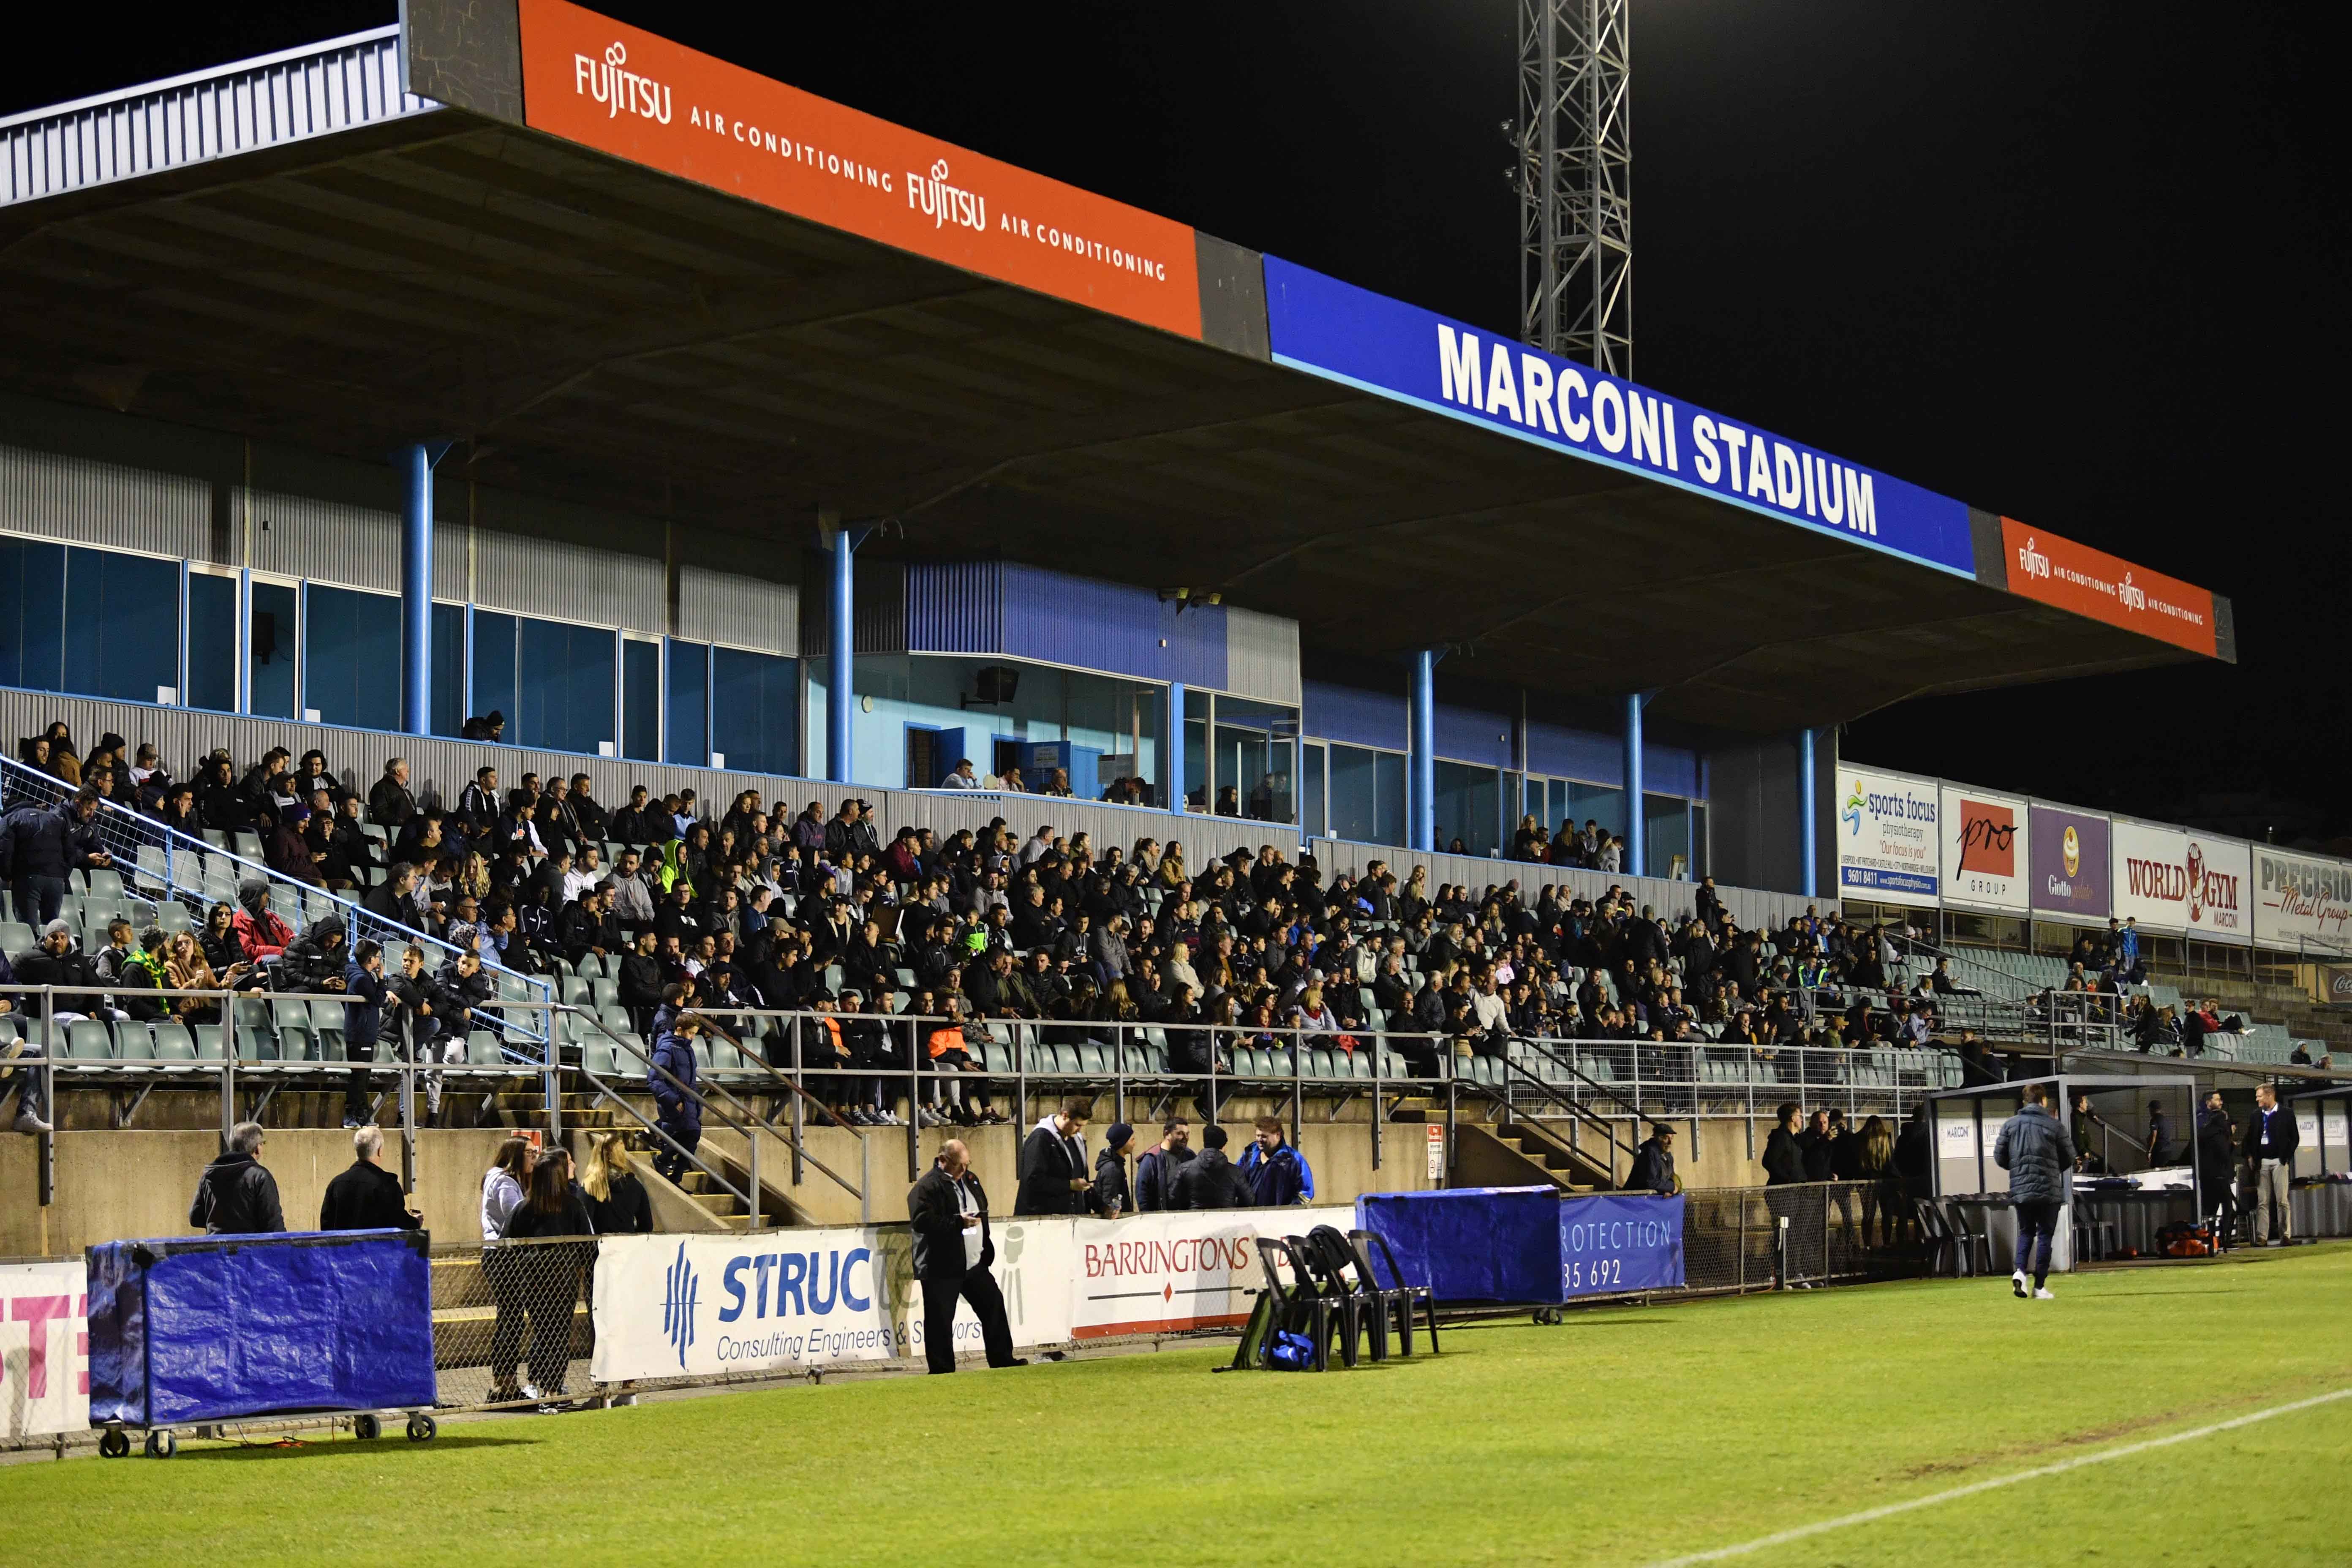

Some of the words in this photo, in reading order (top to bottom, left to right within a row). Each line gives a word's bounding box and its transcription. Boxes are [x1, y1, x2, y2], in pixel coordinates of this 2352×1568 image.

[574, 53, 672, 125] FUJITSU
[691, 106, 725, 135] AIR
[734, 121, 892, 193] CONDITIONING
[906, 172, 985, 231] FUJITSU
[1000, 213, 1030, 238] AIR
[1036, 224, 1165, 281] CONDITIONING
[1437, 324, 1678, 471] MARCONI
[1693, 414, 1877, 536] STADIUM
[2019, 547, 2049, 580] FUJITSU
[2054, 565, 2065, 579] AIR
[2066, 569, 2116, 596] CONDITIONING
[2118, 582, 2145, 612] FUJITSU
[2148, 598, 2159, 610] AIR
[2159, 601, 2203, 626] CONDITIONING
[1869, 792, 1904, 820] sports
[1906, 792, 1935, 823] focus
[1882, 820, 1923, 842] physiotherapy
[1893, 841, 1908, 857] focus
[1908, 845, 1912, 857] is
[1956, 817, 2018, 881] pro
[1848, 869, 1862, 883] 9601
[1863, 871, 1877, 885] 8411
[1971, 879, 2006, 896] GROUP
[2048, 874, 2071, 897] Giotto
[2126, 857, 2185, 901] WORLD
[2205, 870, 2238, 911] GYM
[2260, 857, 2352, 903] PRECISIO
[2213, 911, 2238, 929] MARCONI
[2281, 885, 2315, 916] Metal
[2317, 892, 2348, 932] Group
[1561, 1220, 1670, 1252] ROTECTION
[1085, 1237, 1249, 1278] BARRINGTONS
[1590, 1259, 1621, 1286] 692
[718, 1332, 803, 1361] Consulting
[807, 1328, 890, 1357] Engineers
[896, 1321, 906, 1346] &
